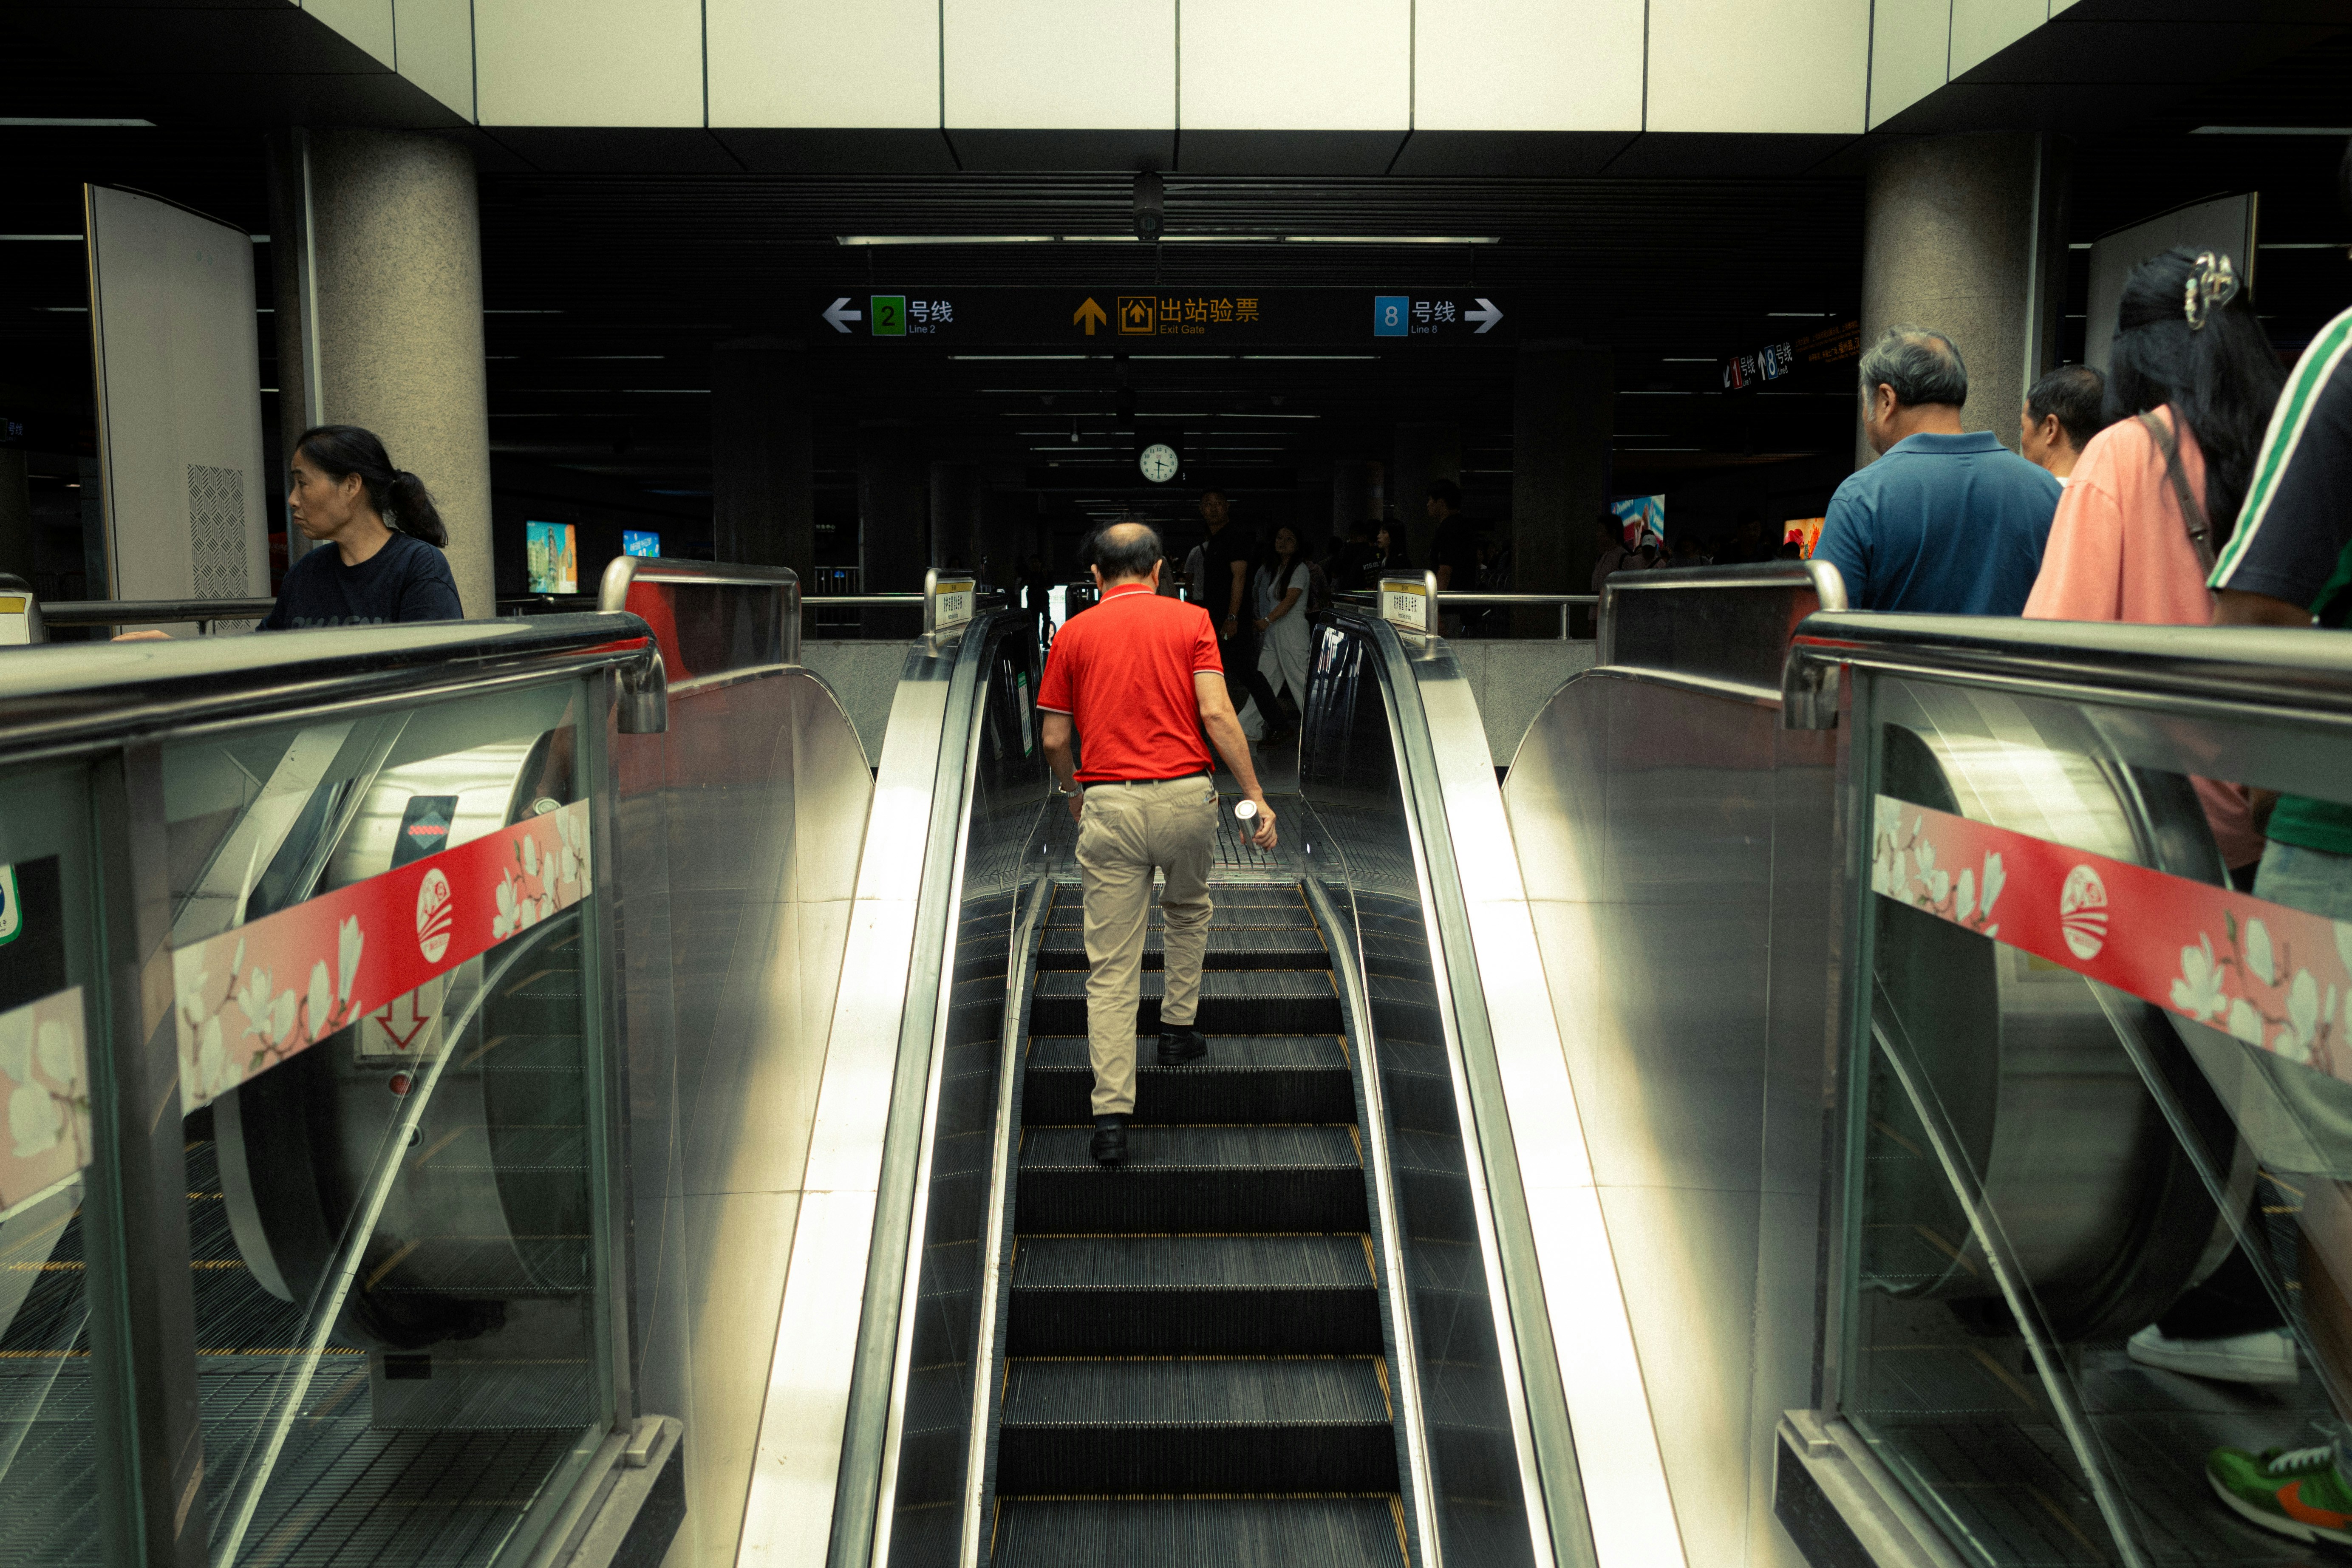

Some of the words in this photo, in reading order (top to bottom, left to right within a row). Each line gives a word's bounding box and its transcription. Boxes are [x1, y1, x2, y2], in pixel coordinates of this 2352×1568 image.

[882, 306, 895, 326] 2
[909, 300, 954, 323] 号线
[1160, 297, 1259, 323] 出站验票
[1385, 306, 1398, 326] 8
[1412, 301, 1455, 323] 号线
[909, 325, 928, 334] Line
[930, 325, 935, 334] 2
[1160, 325, 1178, 334] Exit
[1181, 325, 1205, 334] Gate
[1411, 325, 1429, 334] Line
[1432, 325, 1438, 334] 8
[1741, 354, 1755, 376] 号线
[1767, 349, 1775, 376] 8
[1776, 341, 1792, 364] 号线
